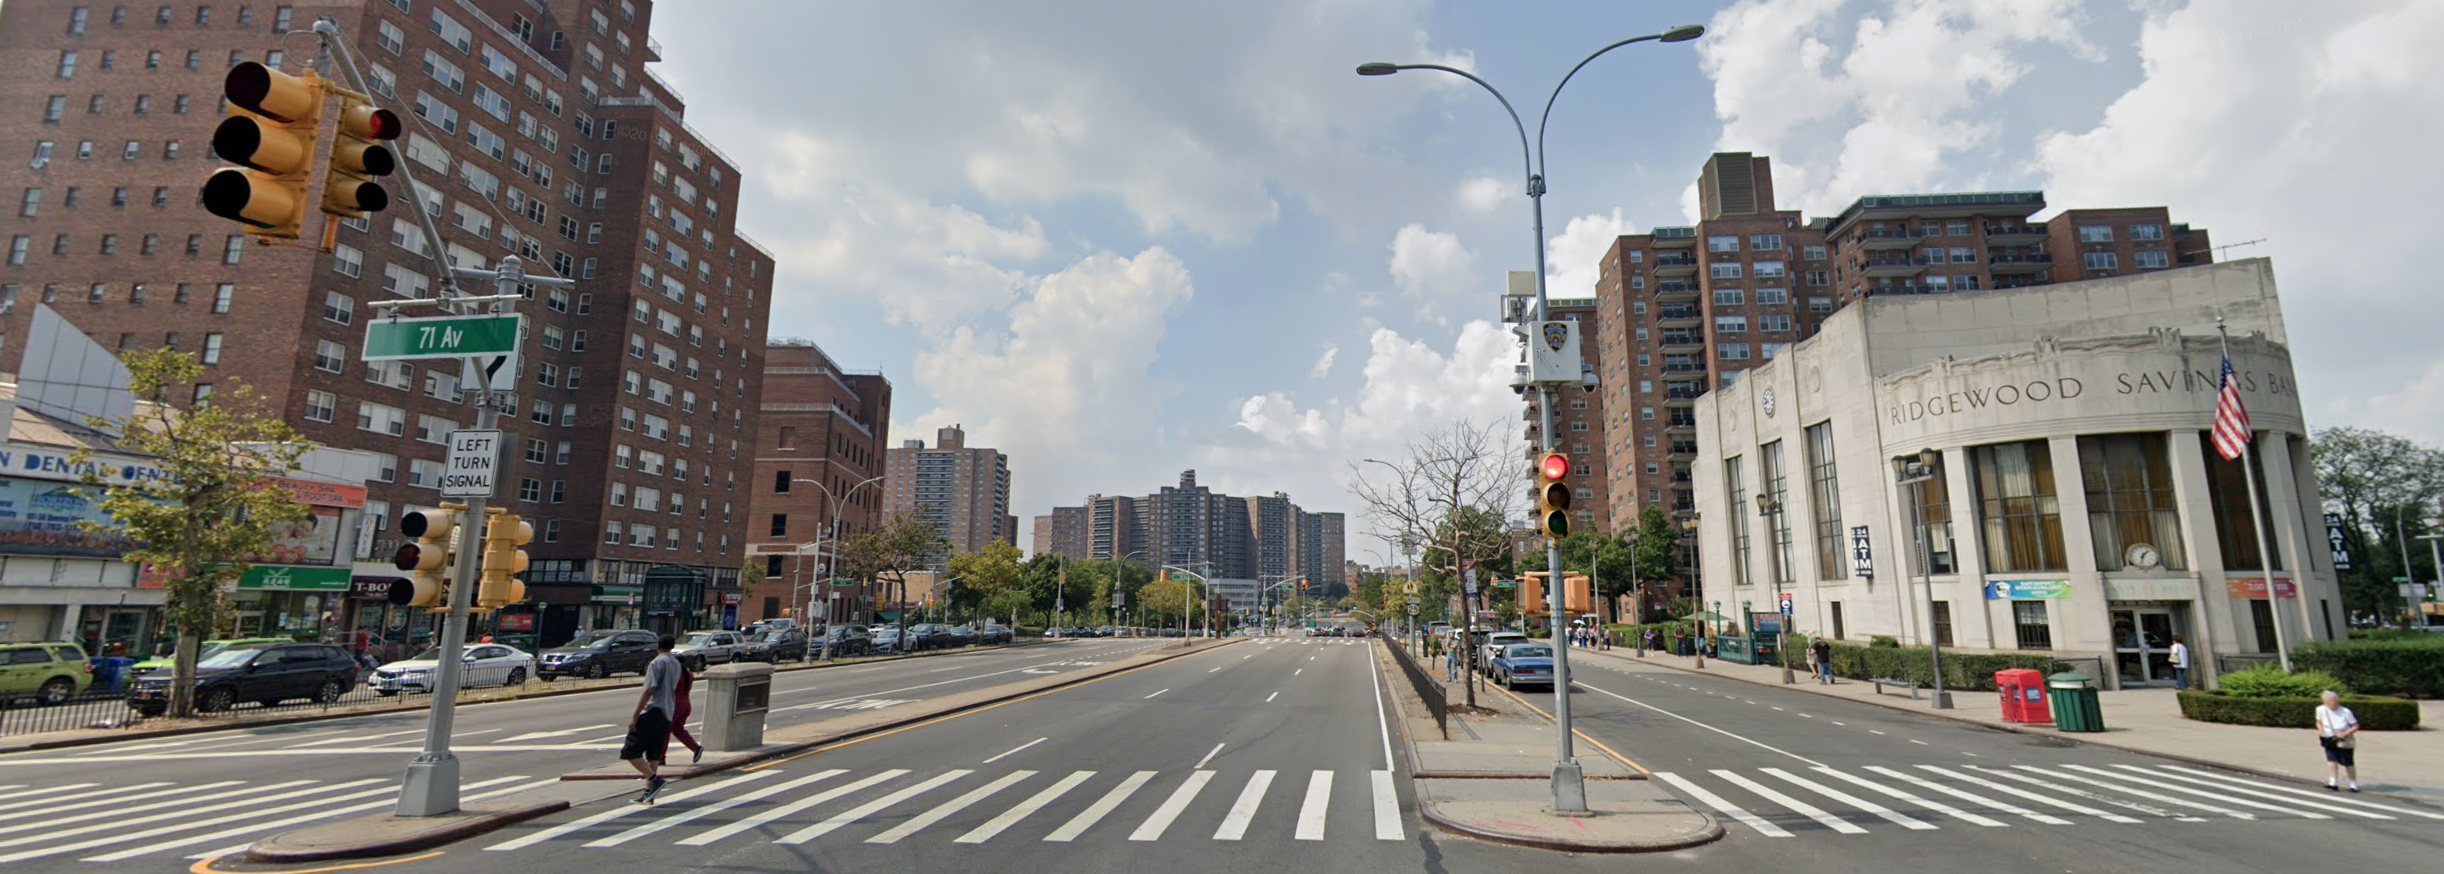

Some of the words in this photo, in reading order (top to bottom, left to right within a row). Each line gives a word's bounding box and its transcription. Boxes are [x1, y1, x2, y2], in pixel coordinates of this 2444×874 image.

[418, 326, 436, 349] 71
[441, 325, 464, 348] Av
[1891, 377, 2083, 426] RIDGEWOOD
[457, 438, 492, 452] LEFT
[454, 456, 491, 470] TURN
[446, 475, 491, 488] SIGNAL
[2325, 515, 2340, 523] 24
[2329, 528, 2349, 562] ATM
[1858, 538, 1872, 569] ATM
[355, 582, 391, 591] T-BO
[1408, 605, 1419, 614] 25
